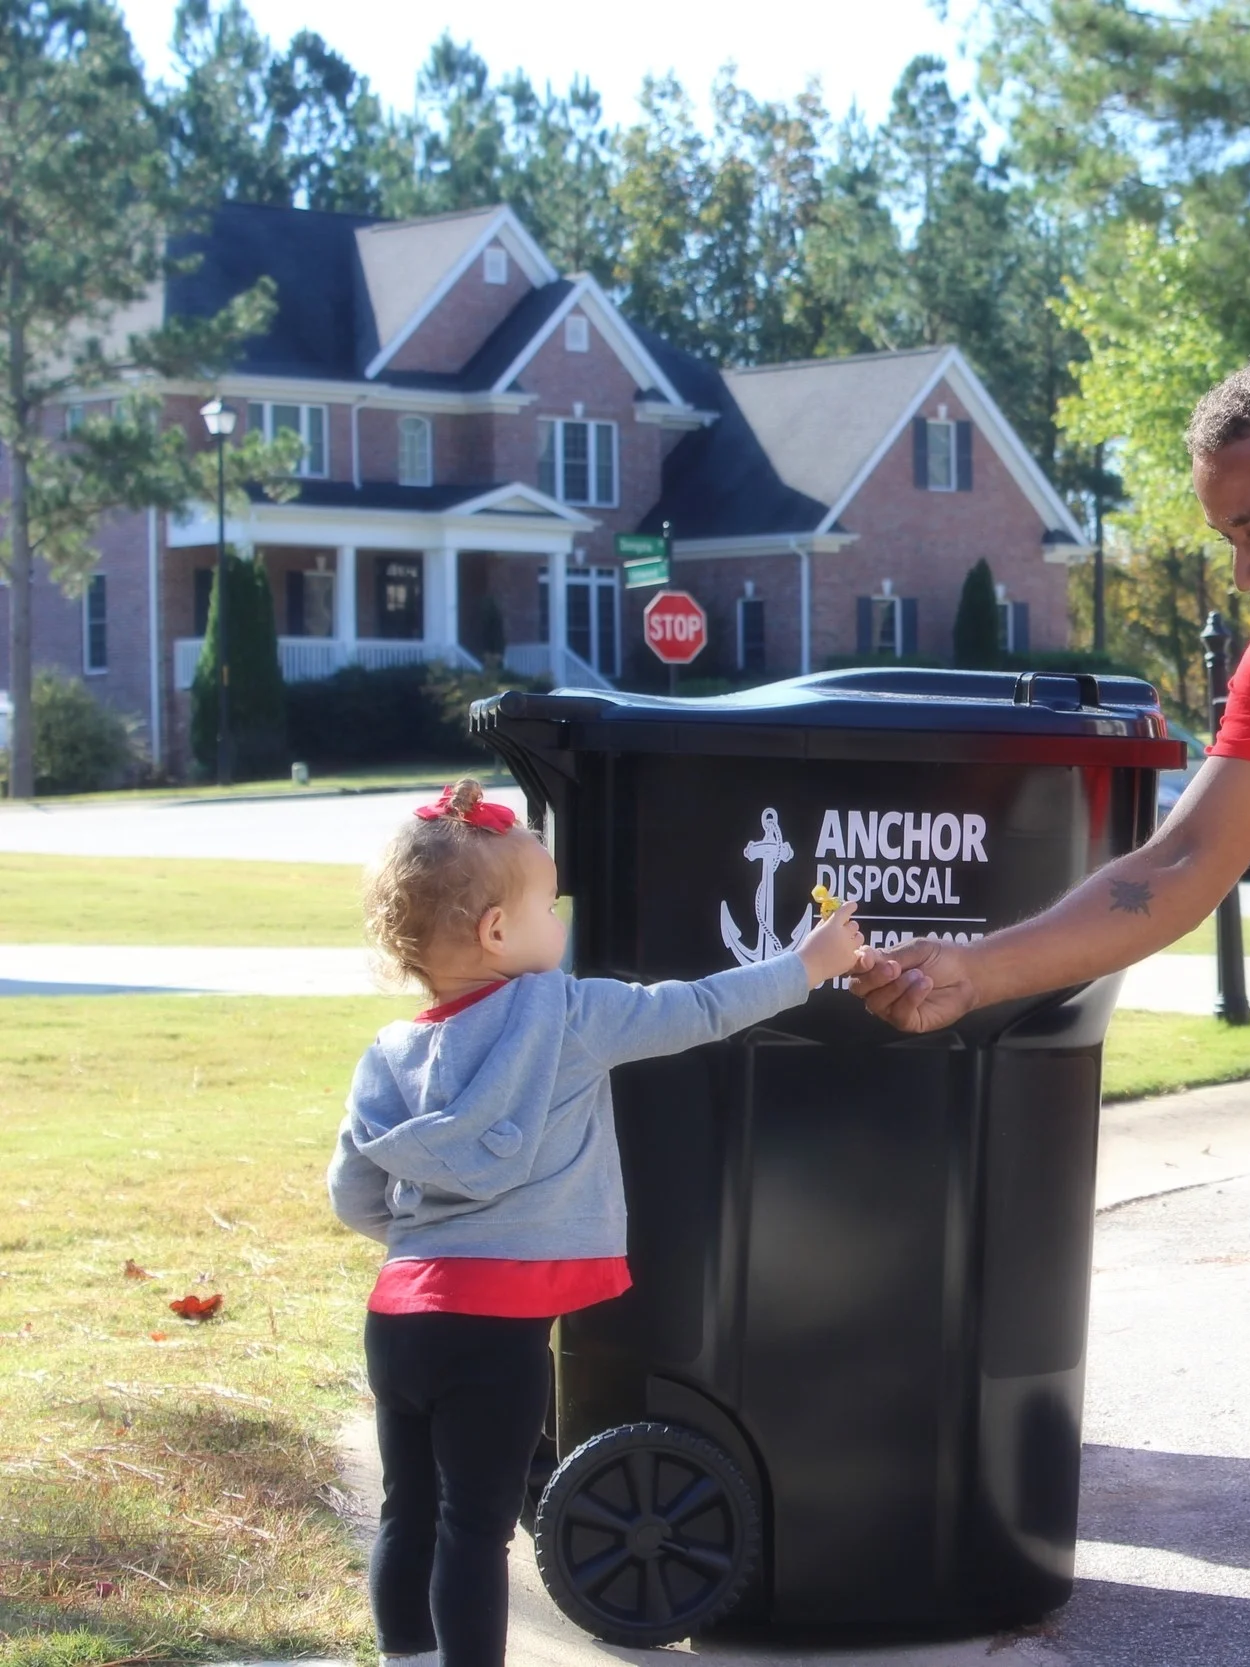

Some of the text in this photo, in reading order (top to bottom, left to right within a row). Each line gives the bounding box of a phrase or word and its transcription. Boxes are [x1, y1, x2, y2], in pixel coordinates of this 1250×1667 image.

[650, 613, 701, 641] STOP
[815, 810, 988, 862] ANCHOR
[816, 864, 960, 904] DISPOSAL
